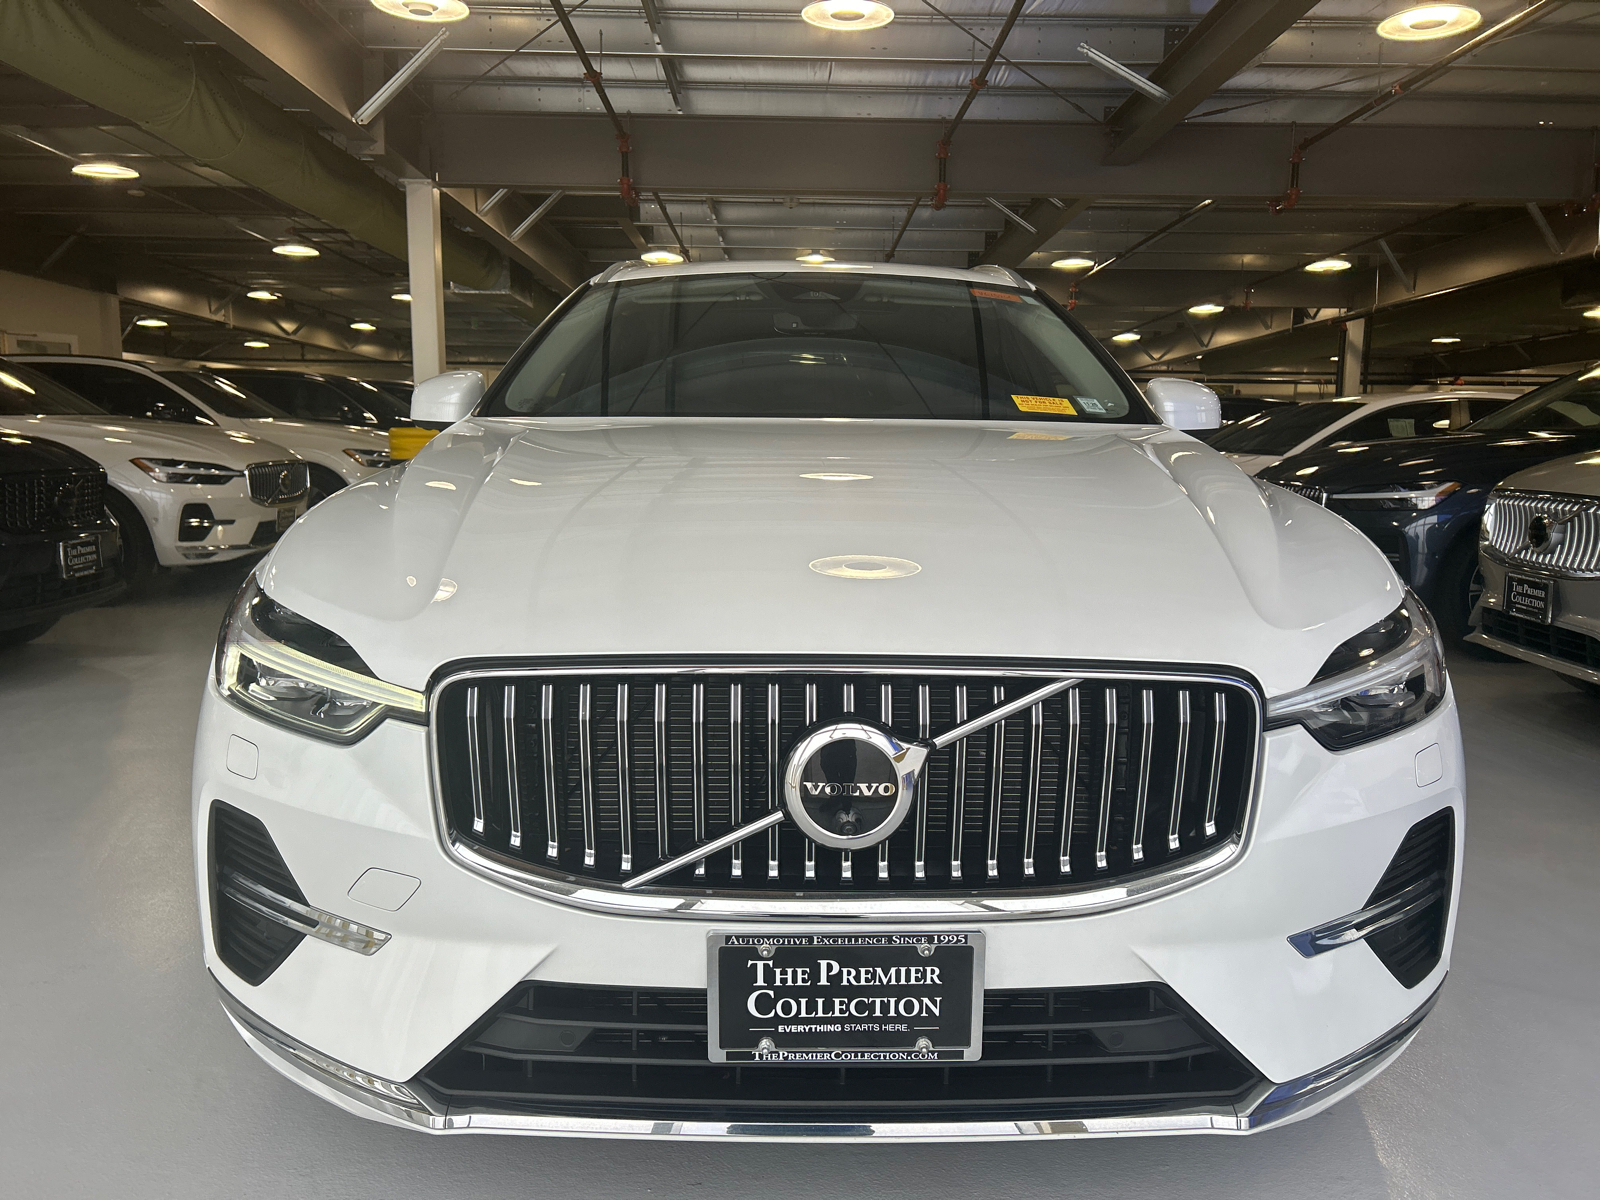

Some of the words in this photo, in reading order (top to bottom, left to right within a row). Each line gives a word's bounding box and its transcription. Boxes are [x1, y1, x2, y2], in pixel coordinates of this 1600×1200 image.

[1512, 581, 1524, 593] THE
[1524, 584, 1546, 598] PREMIER
[1511, 592, 1545, 609] COLLECTION
[803, 782, 896, 796] VOLVO
[728, 935, 809, 945] AUTOMOTIVE
[813, 935, 889, 945] EXCELLENCE
[892, 935, 928, 945] SINCE
[932, 934, 966, 944] 1995
[747, 959, 811, 986] THE
[816, 959, 942, 986] PREMIER
[747, 989, 942, 1018] COLLECTION
[778, 1024, 842, 1032] EVERYTHING
[843, 1024, 880, 1032] STARTS
[882, 1023, 910, 1032] HERE.
